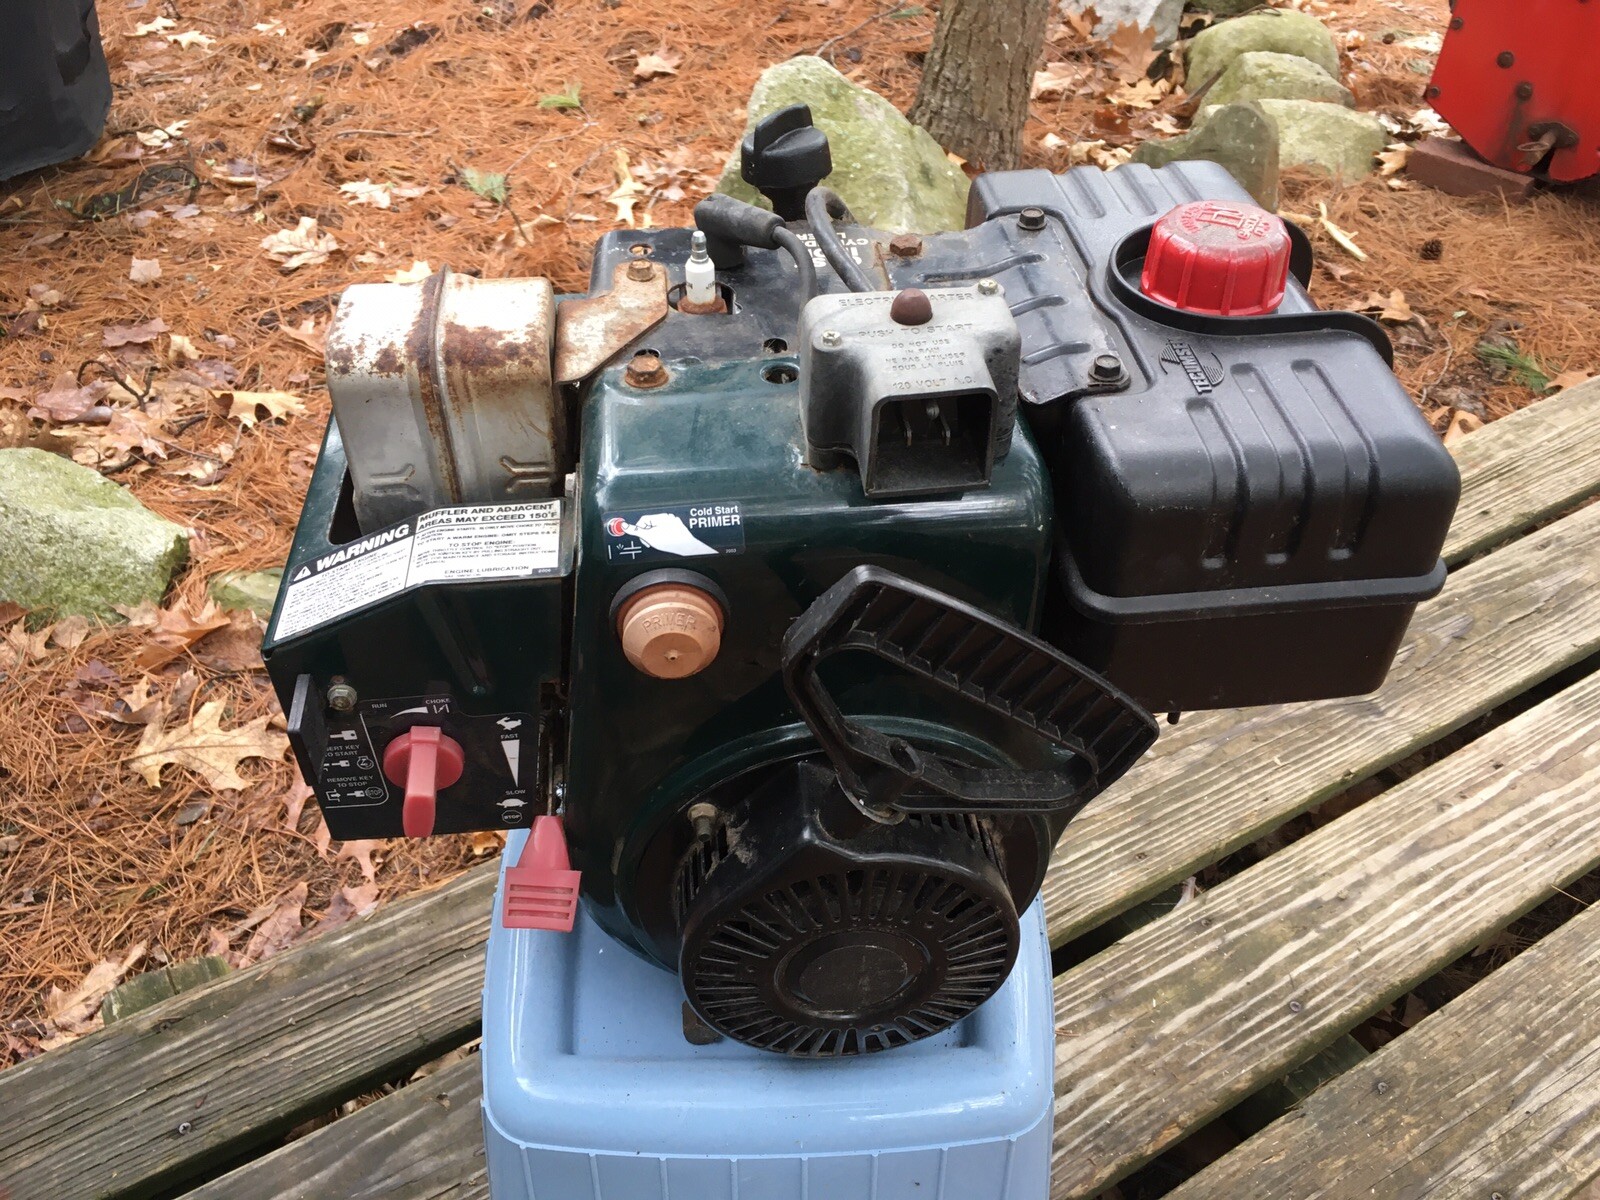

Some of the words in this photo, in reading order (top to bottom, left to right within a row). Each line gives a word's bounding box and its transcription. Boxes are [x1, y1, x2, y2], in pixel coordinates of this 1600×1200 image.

[927, 323, 973, 334] START
[916, 377, 947, 388] VOLT
[419, 507, 469, 523] MUFFLER
[471, 506, 494, 514] AND
[496, 503, 555, 513] ADJACENT
[690, 507, 713, 517] Cold
[714, 505, 739, 515] Start
[418, 516, 452, 531] AREAS
[455, 515, 479, 523] MAY
[481, 512, 526, 522] EXCEED
[689, 514, 741, 529] PRIMER
[316, 523, 410, 572] WARNING
[642, 611, 696, 634] PRIMER
[425, 697, 452, 705] CHOKE
